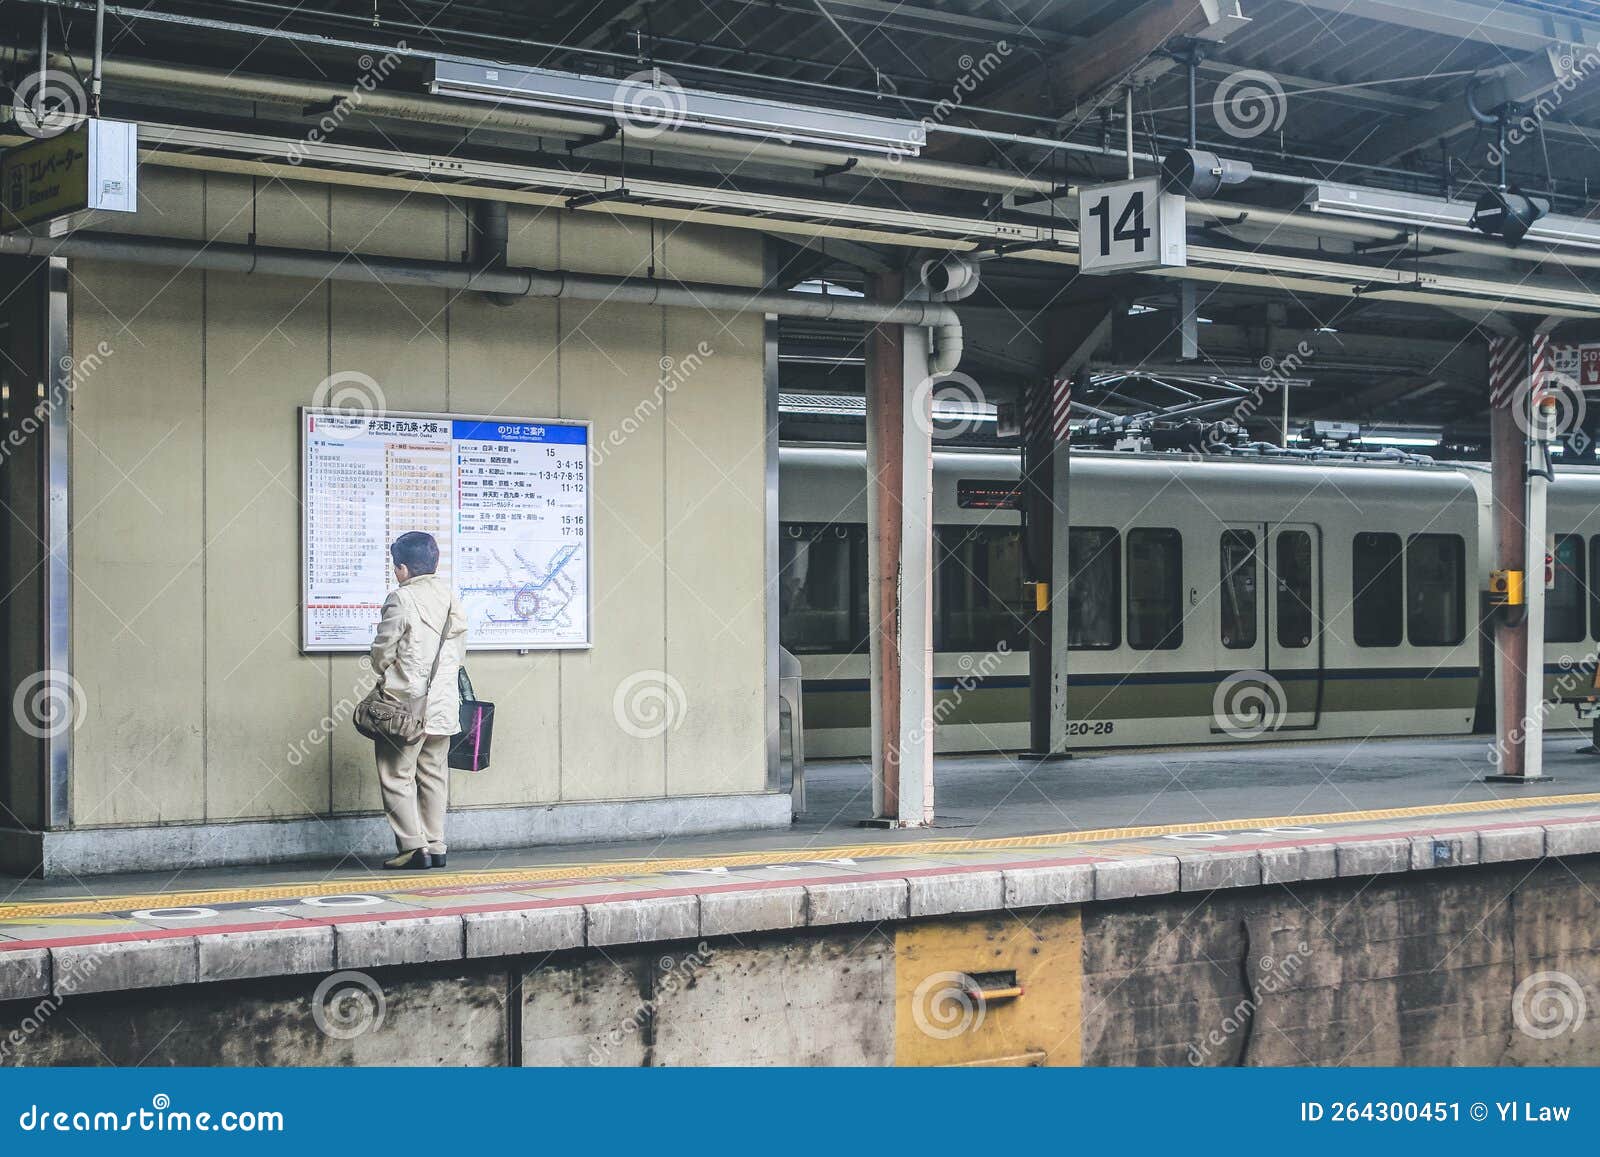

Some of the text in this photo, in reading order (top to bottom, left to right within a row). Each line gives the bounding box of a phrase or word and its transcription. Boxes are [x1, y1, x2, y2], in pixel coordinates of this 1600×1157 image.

[1089, 191, 1151, 257] 14
[1583, 351, 1600, 362] SO
[498, 426, 520, 435] のりば
[546, 448, 556, 457] 15
[546, 499, 556, 507] 14
[1066, 722, 1113, 736] 20-28
